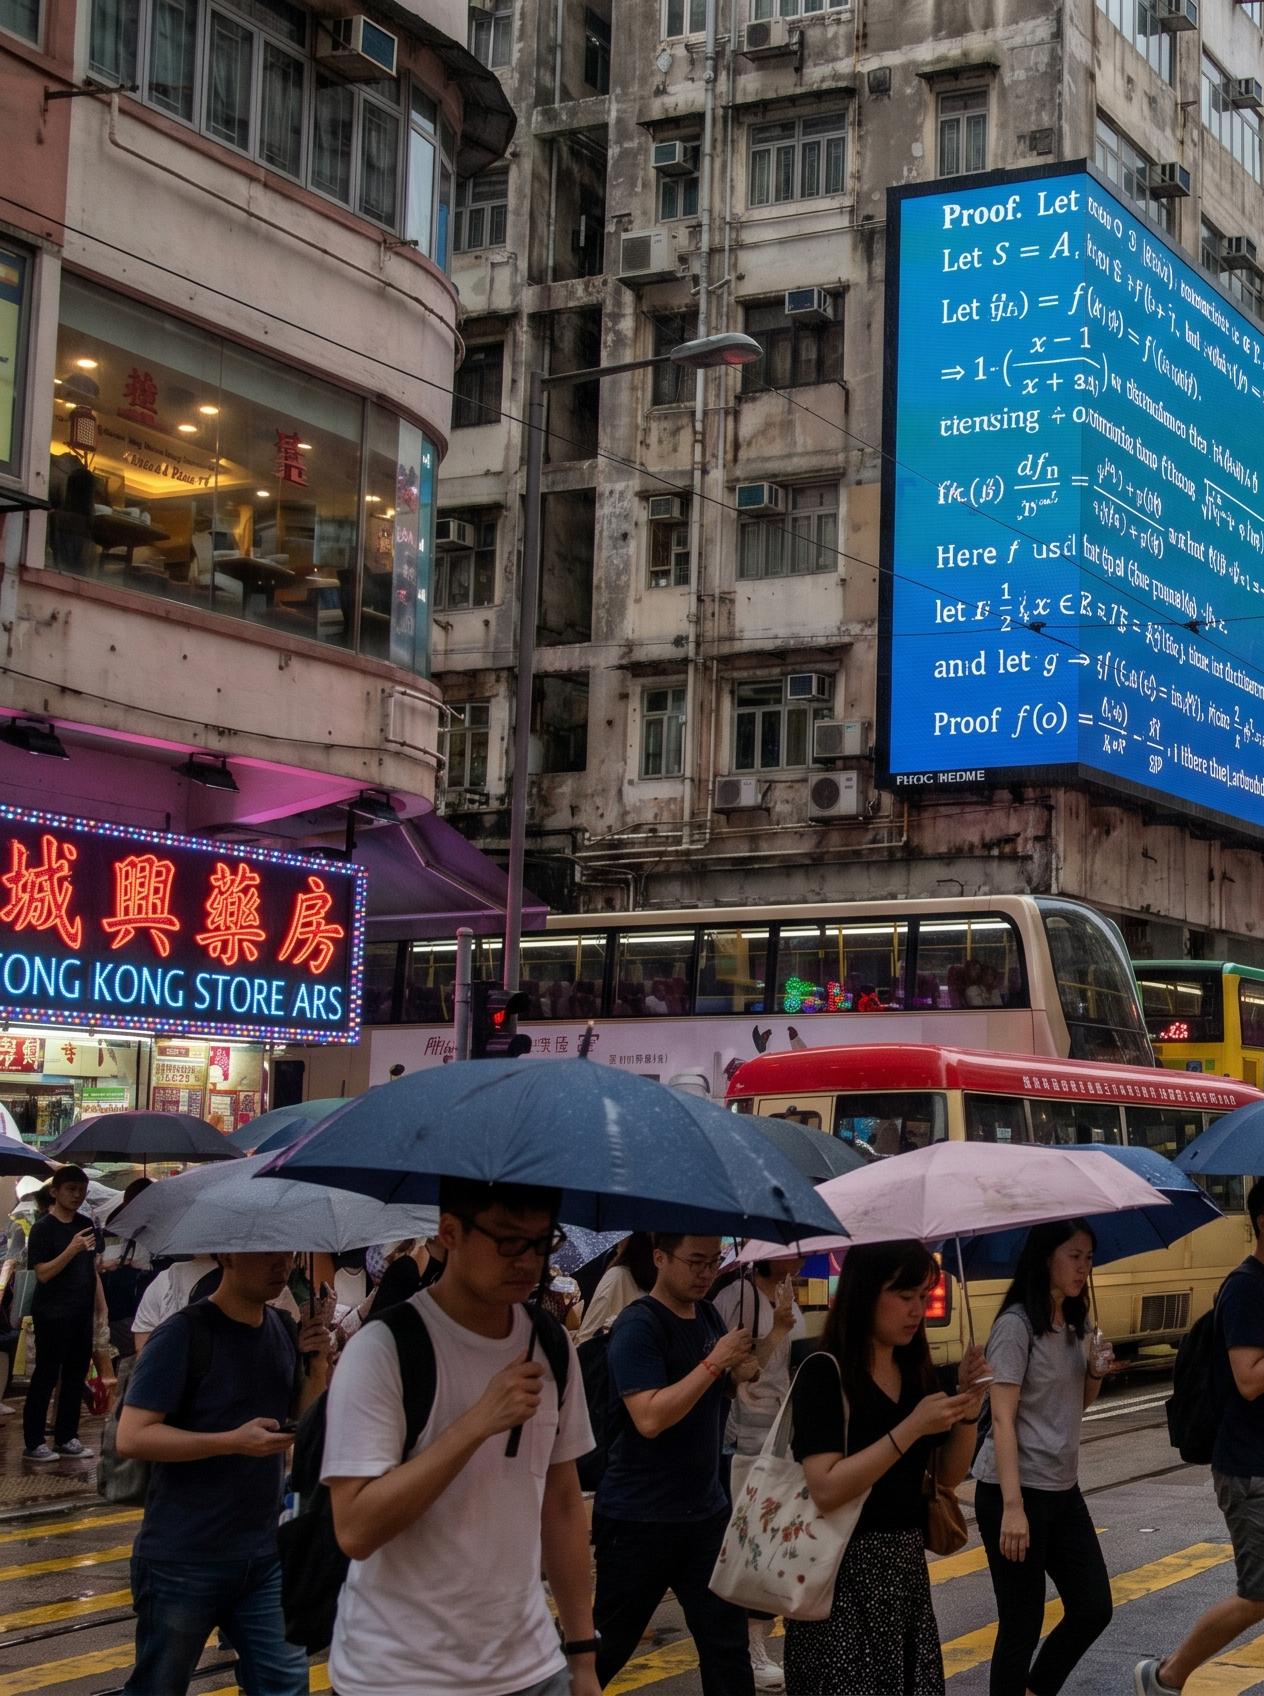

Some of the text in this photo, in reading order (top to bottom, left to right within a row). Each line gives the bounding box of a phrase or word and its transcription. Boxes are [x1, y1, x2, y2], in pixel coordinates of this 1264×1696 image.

[942, 190, 1080, 230] Proof. Let
[942, 247, 983, 273] Let
[992, 241, 1010, 266] S
[941, 298, 981, 324] Let
[936, 544, 997, 568] Here
[935, 599, 967, 624] let
[998, 649, 1031, 674] let
[934, 707, 1002, 736] Proof
[0, 953, 343, 1021] ONG KONG STORE ARS
